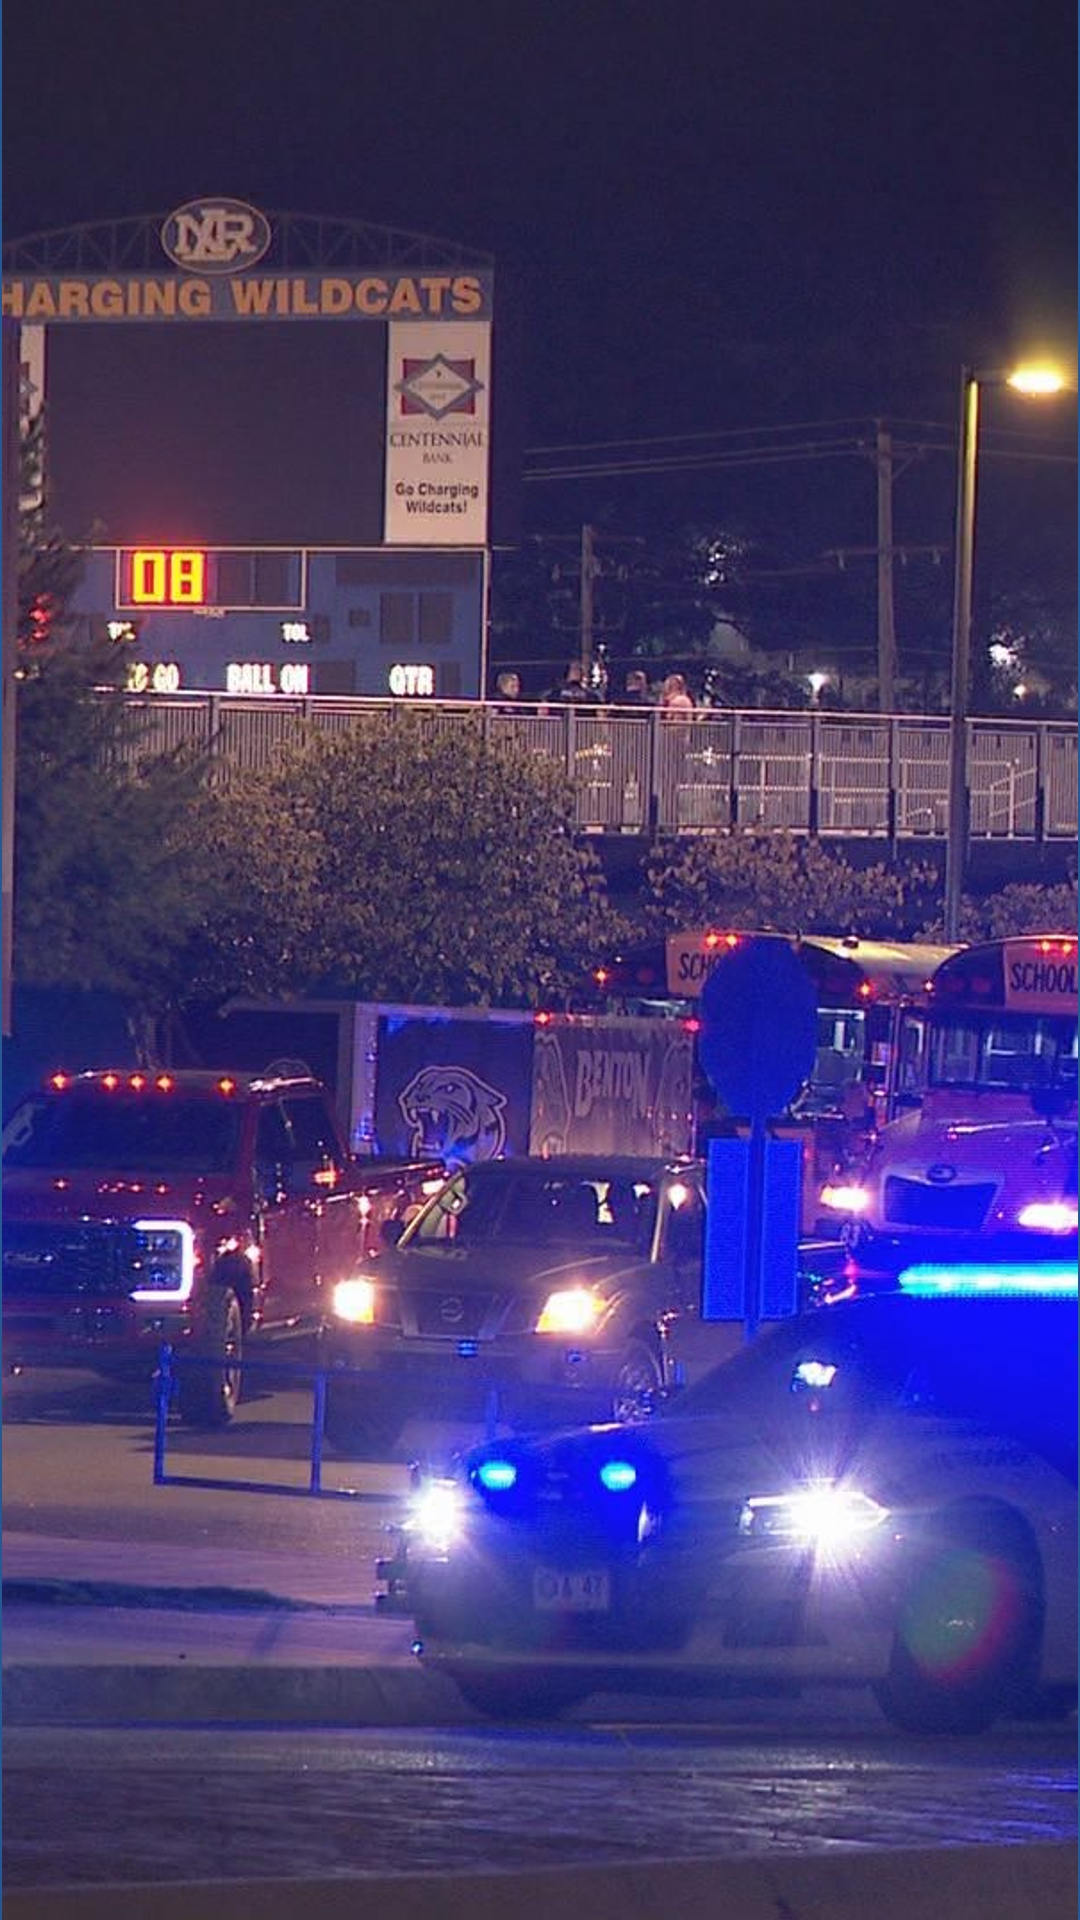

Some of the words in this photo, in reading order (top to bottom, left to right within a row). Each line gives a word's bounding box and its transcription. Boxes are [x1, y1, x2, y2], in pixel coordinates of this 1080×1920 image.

[232, 277, 483, 315] WILDCATS
[390, 431, 485, 449] CENTENNIAL
[422, 452, 453, 465] BANK
[395, 482, 414, 496] Go
[418, 482, 479, 500] Charging
[406, 501, 468, 515] Wildcats!
[131, 551, 206, 605] 08
[282, 623, 310, 642] TOL
[153, 663, 180, 692] GO
[226, 663, 276, 693] BALL
[280, 663, 310, 693] ON
[389, 665, 434, 696] QTR
[1010, 963, 1078, 994] SCHOOL
[574, 1049, 651, 1119] BENTON
